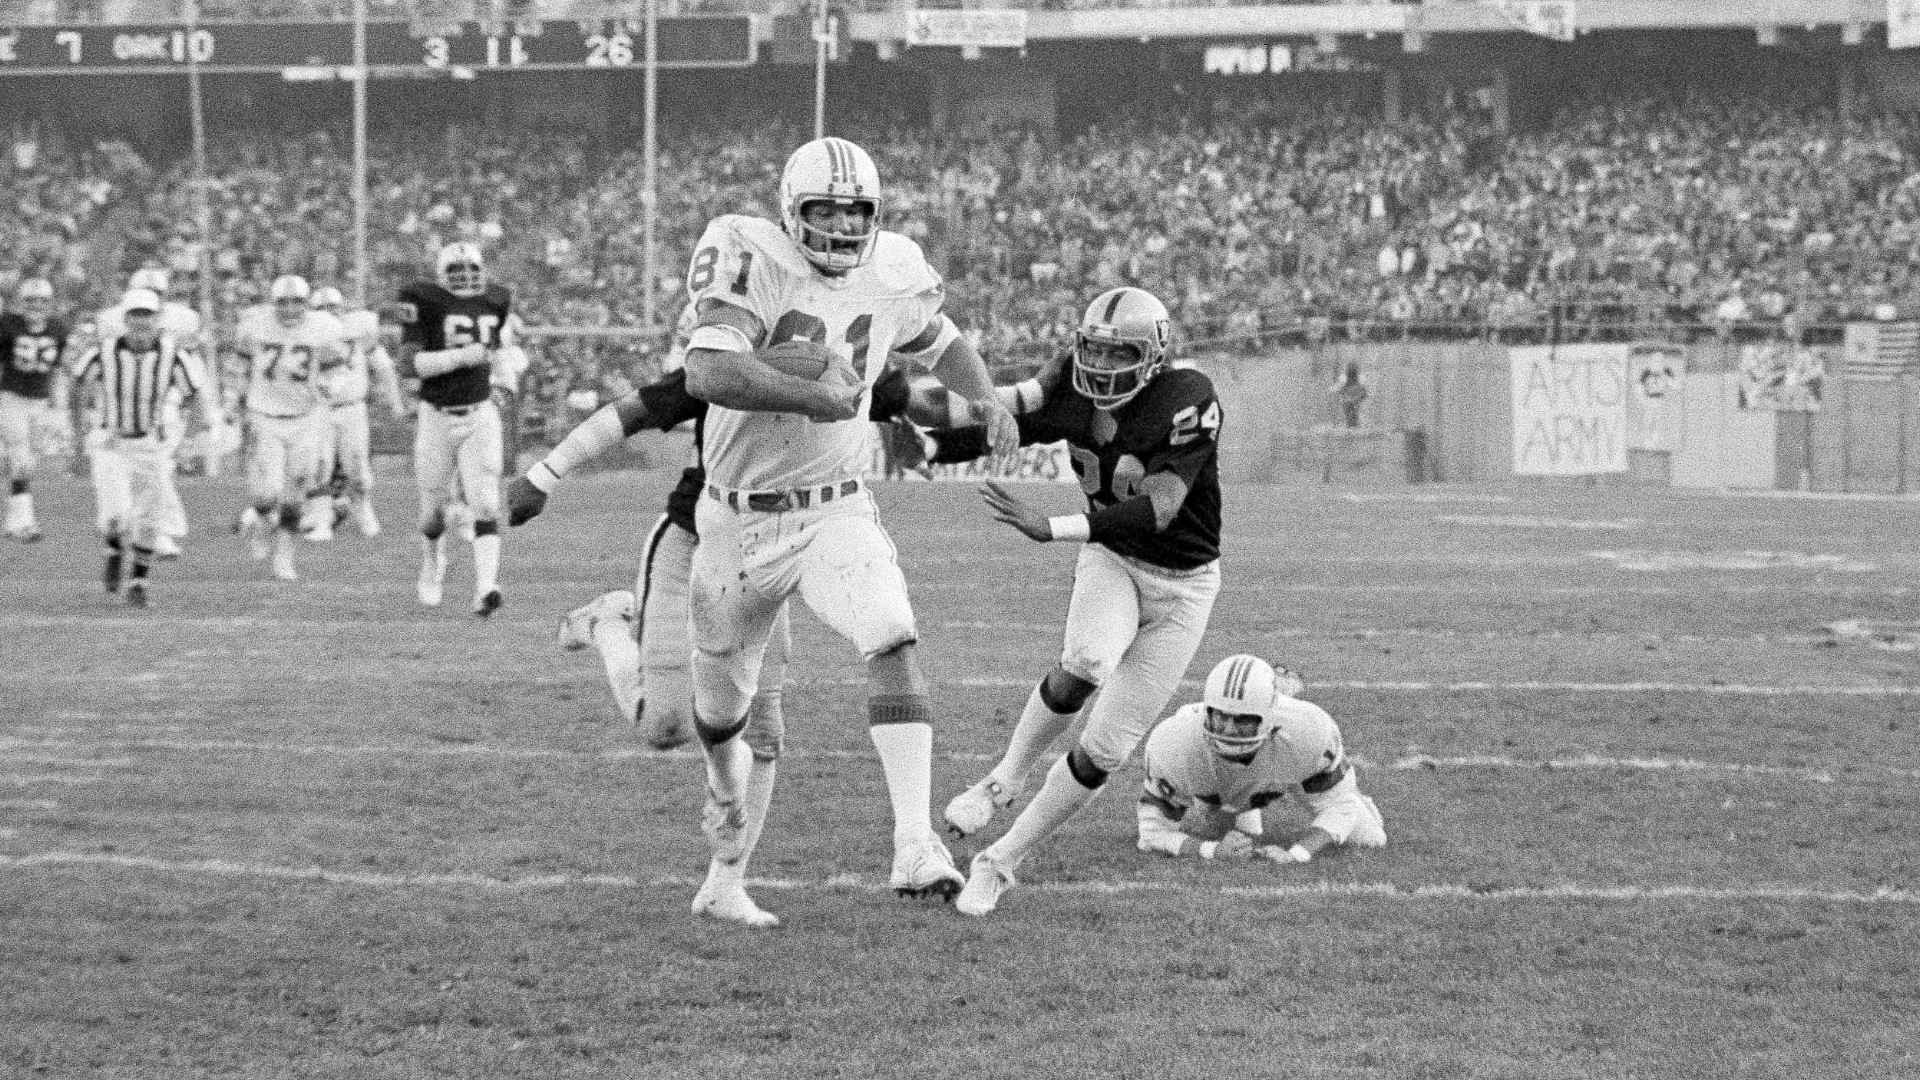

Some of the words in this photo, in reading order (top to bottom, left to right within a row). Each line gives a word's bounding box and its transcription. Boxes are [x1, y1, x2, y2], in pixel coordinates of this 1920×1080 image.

[55, 31, 82, 63] 7
[171, 30, 215, 62] 10
[422, 36, 449, 68] 3
[585, 34, 634, 67] 26
[690, 246, 754, 296] 81
[261, 342, 313, 382] 73
[1524, 360, 1622, 407] ARTS
[1169, 401, 1220, 446] 24
[1521, 414, 1622, 464] ARMY
